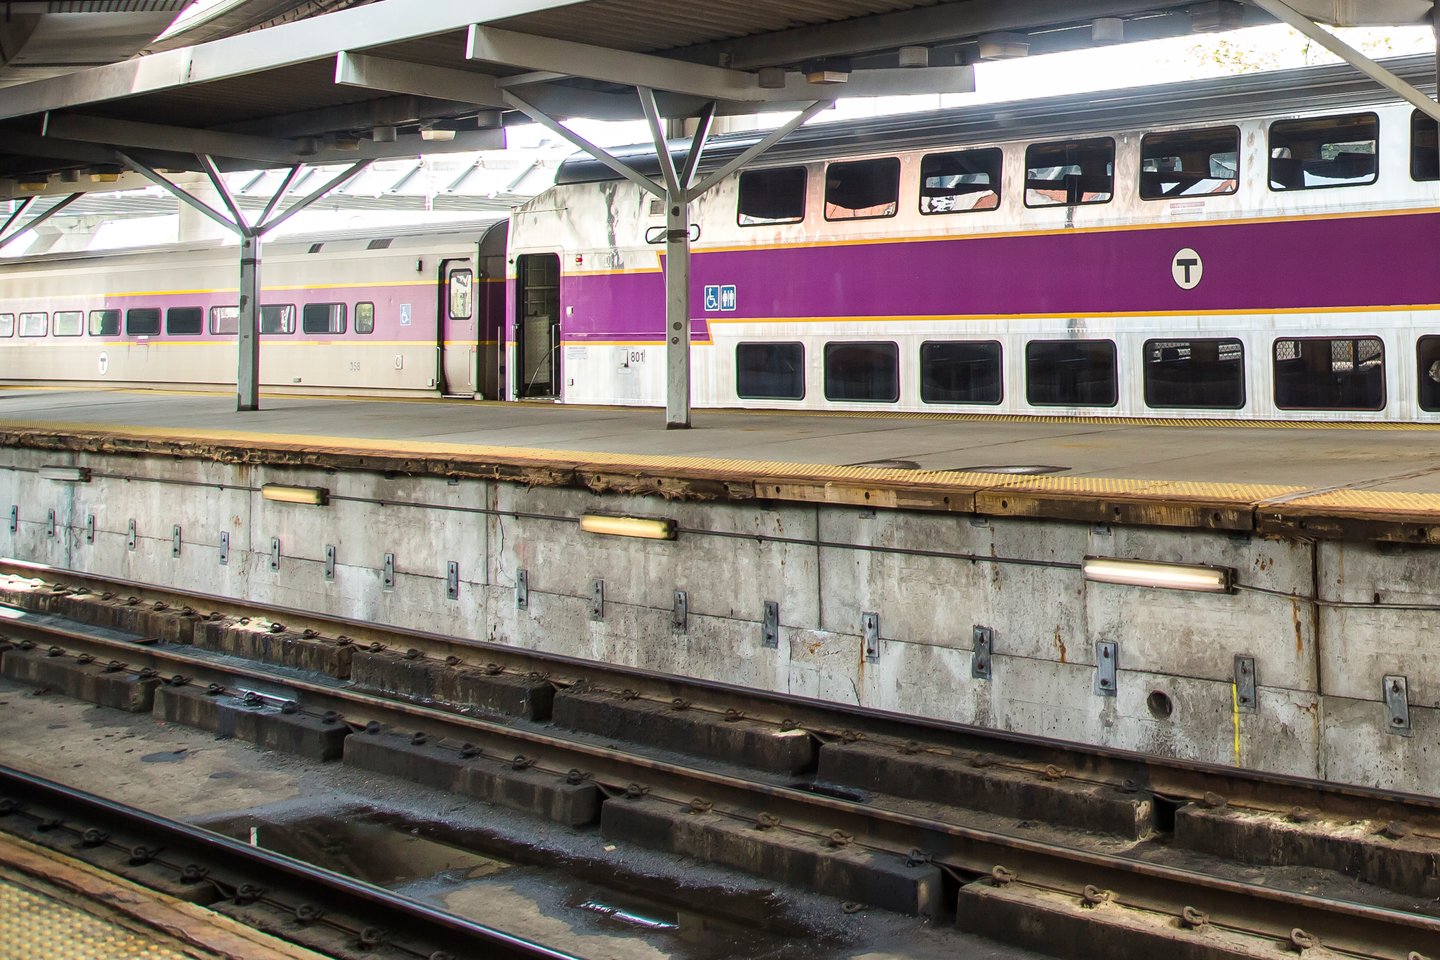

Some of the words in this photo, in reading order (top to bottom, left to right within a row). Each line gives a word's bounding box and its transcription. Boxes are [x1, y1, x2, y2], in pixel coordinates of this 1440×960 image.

[1176, 258, 1198, 284] T
[100, 357, 107, 371] T
[630, 351, 644, 363] 801
